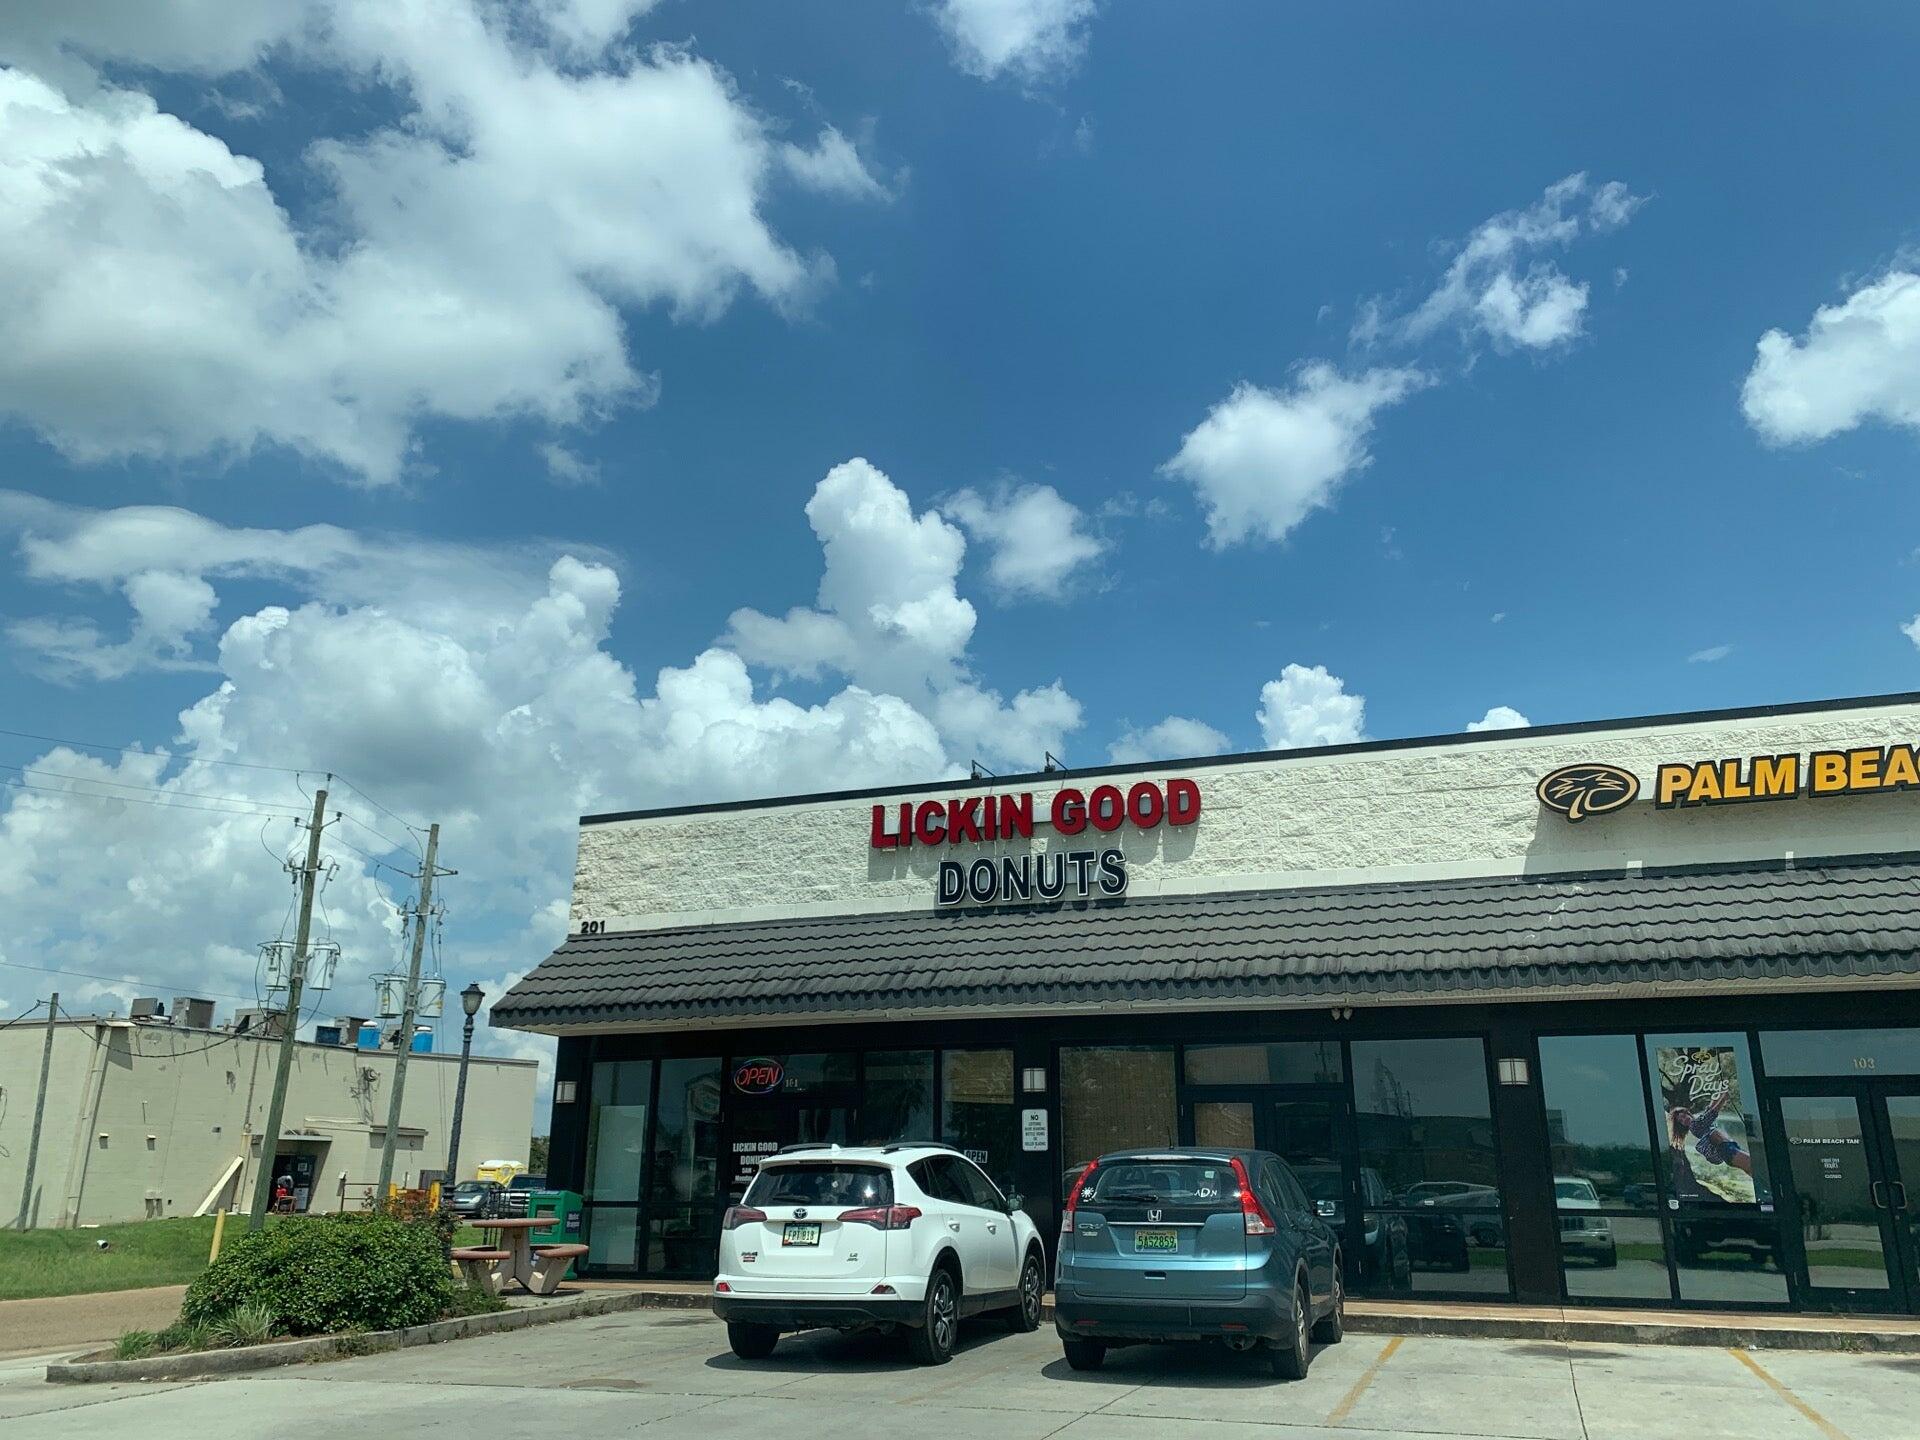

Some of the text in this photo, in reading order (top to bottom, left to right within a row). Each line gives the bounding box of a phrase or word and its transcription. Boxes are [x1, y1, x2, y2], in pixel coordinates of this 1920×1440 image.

[1657, 745, 1920, 807] PALM BEA
[871, 779, 1202, 848] LICKIN GOOD
[937, 849, 1129, 906] DONUTS
[580, 920, 605, 934] 201
[1668, 1055, 1722, 1083] Spray
[1853, 1057, 1875, 1069] 103
[736, 1066, 780, 1086] OPEN
[1688, 1075, 1730, 1101] Days
[732, 1142, 778, 1152] LICKIN GOOD
[966, 1151, 987, 1163] OPEN
